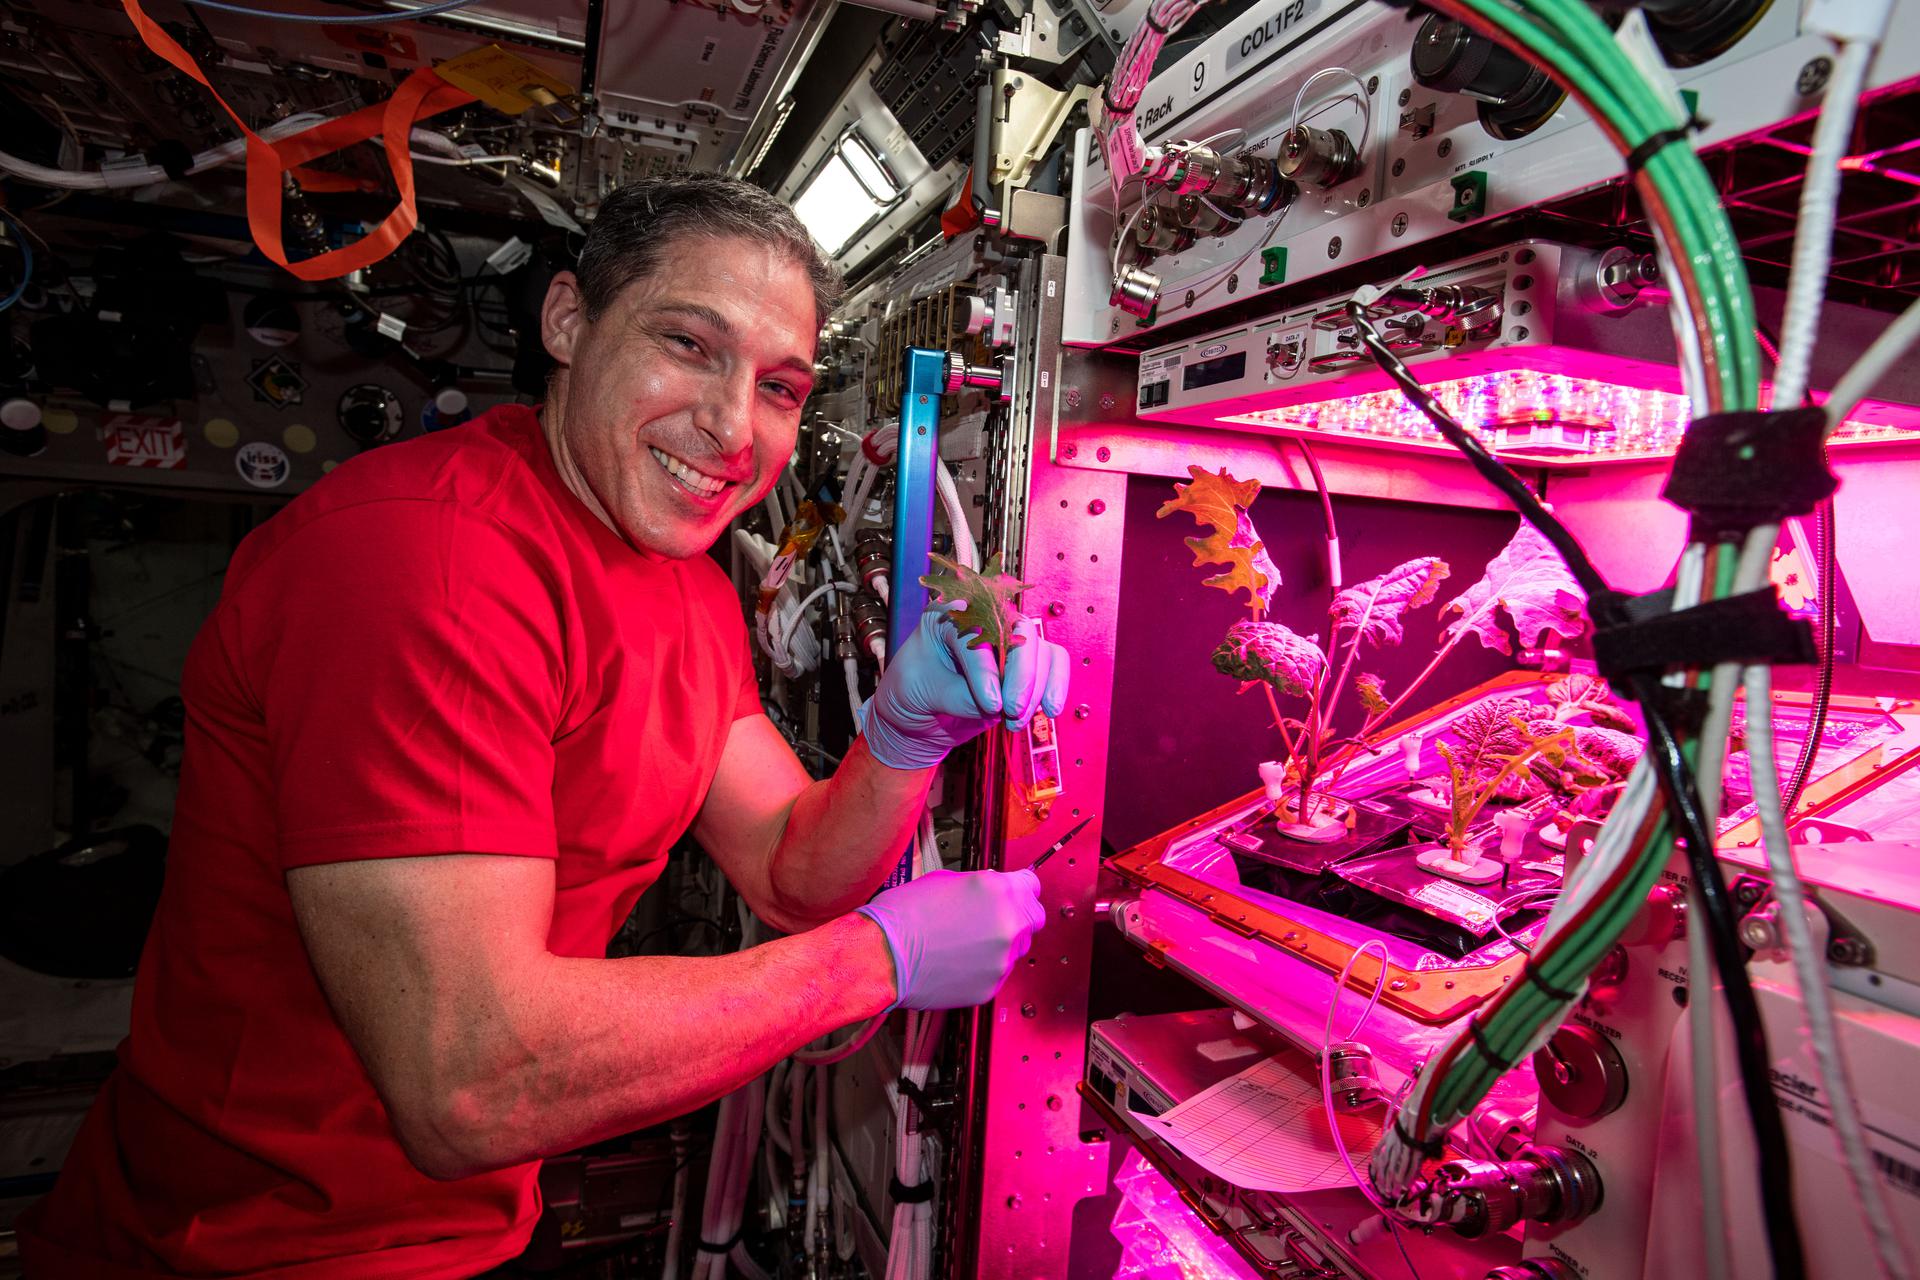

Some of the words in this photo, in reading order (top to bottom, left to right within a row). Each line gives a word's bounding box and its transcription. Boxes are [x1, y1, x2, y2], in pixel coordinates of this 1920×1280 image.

[1240, 0, 1305, 58] COL1F2
[754, 43, 776, 69] Science
[1193, 61, 1206, 92] 9
[1144, 95, 1174, 130] Rack
[1235, 136, 1270, 160] ETHERNET
[1338, 327, 1354, 336] POWER
[117, 427, 172, 457] EXIT
[246, 450, 279, 465] iriss
[1438, 880, 1458, 891] Small
[1458, 888, 1477, 899] Plant
[1658, 967, 1689, 984] RECEP
[1593, 1021, 1622, 1040] FILTER
[1565, 1134, 1587, 1153] DATA
[1587, 1147, 1599, 1160] J2
[1549, 1243, 1579, 1270] POWER
[1580, 1264, 1590, 1277] J1
